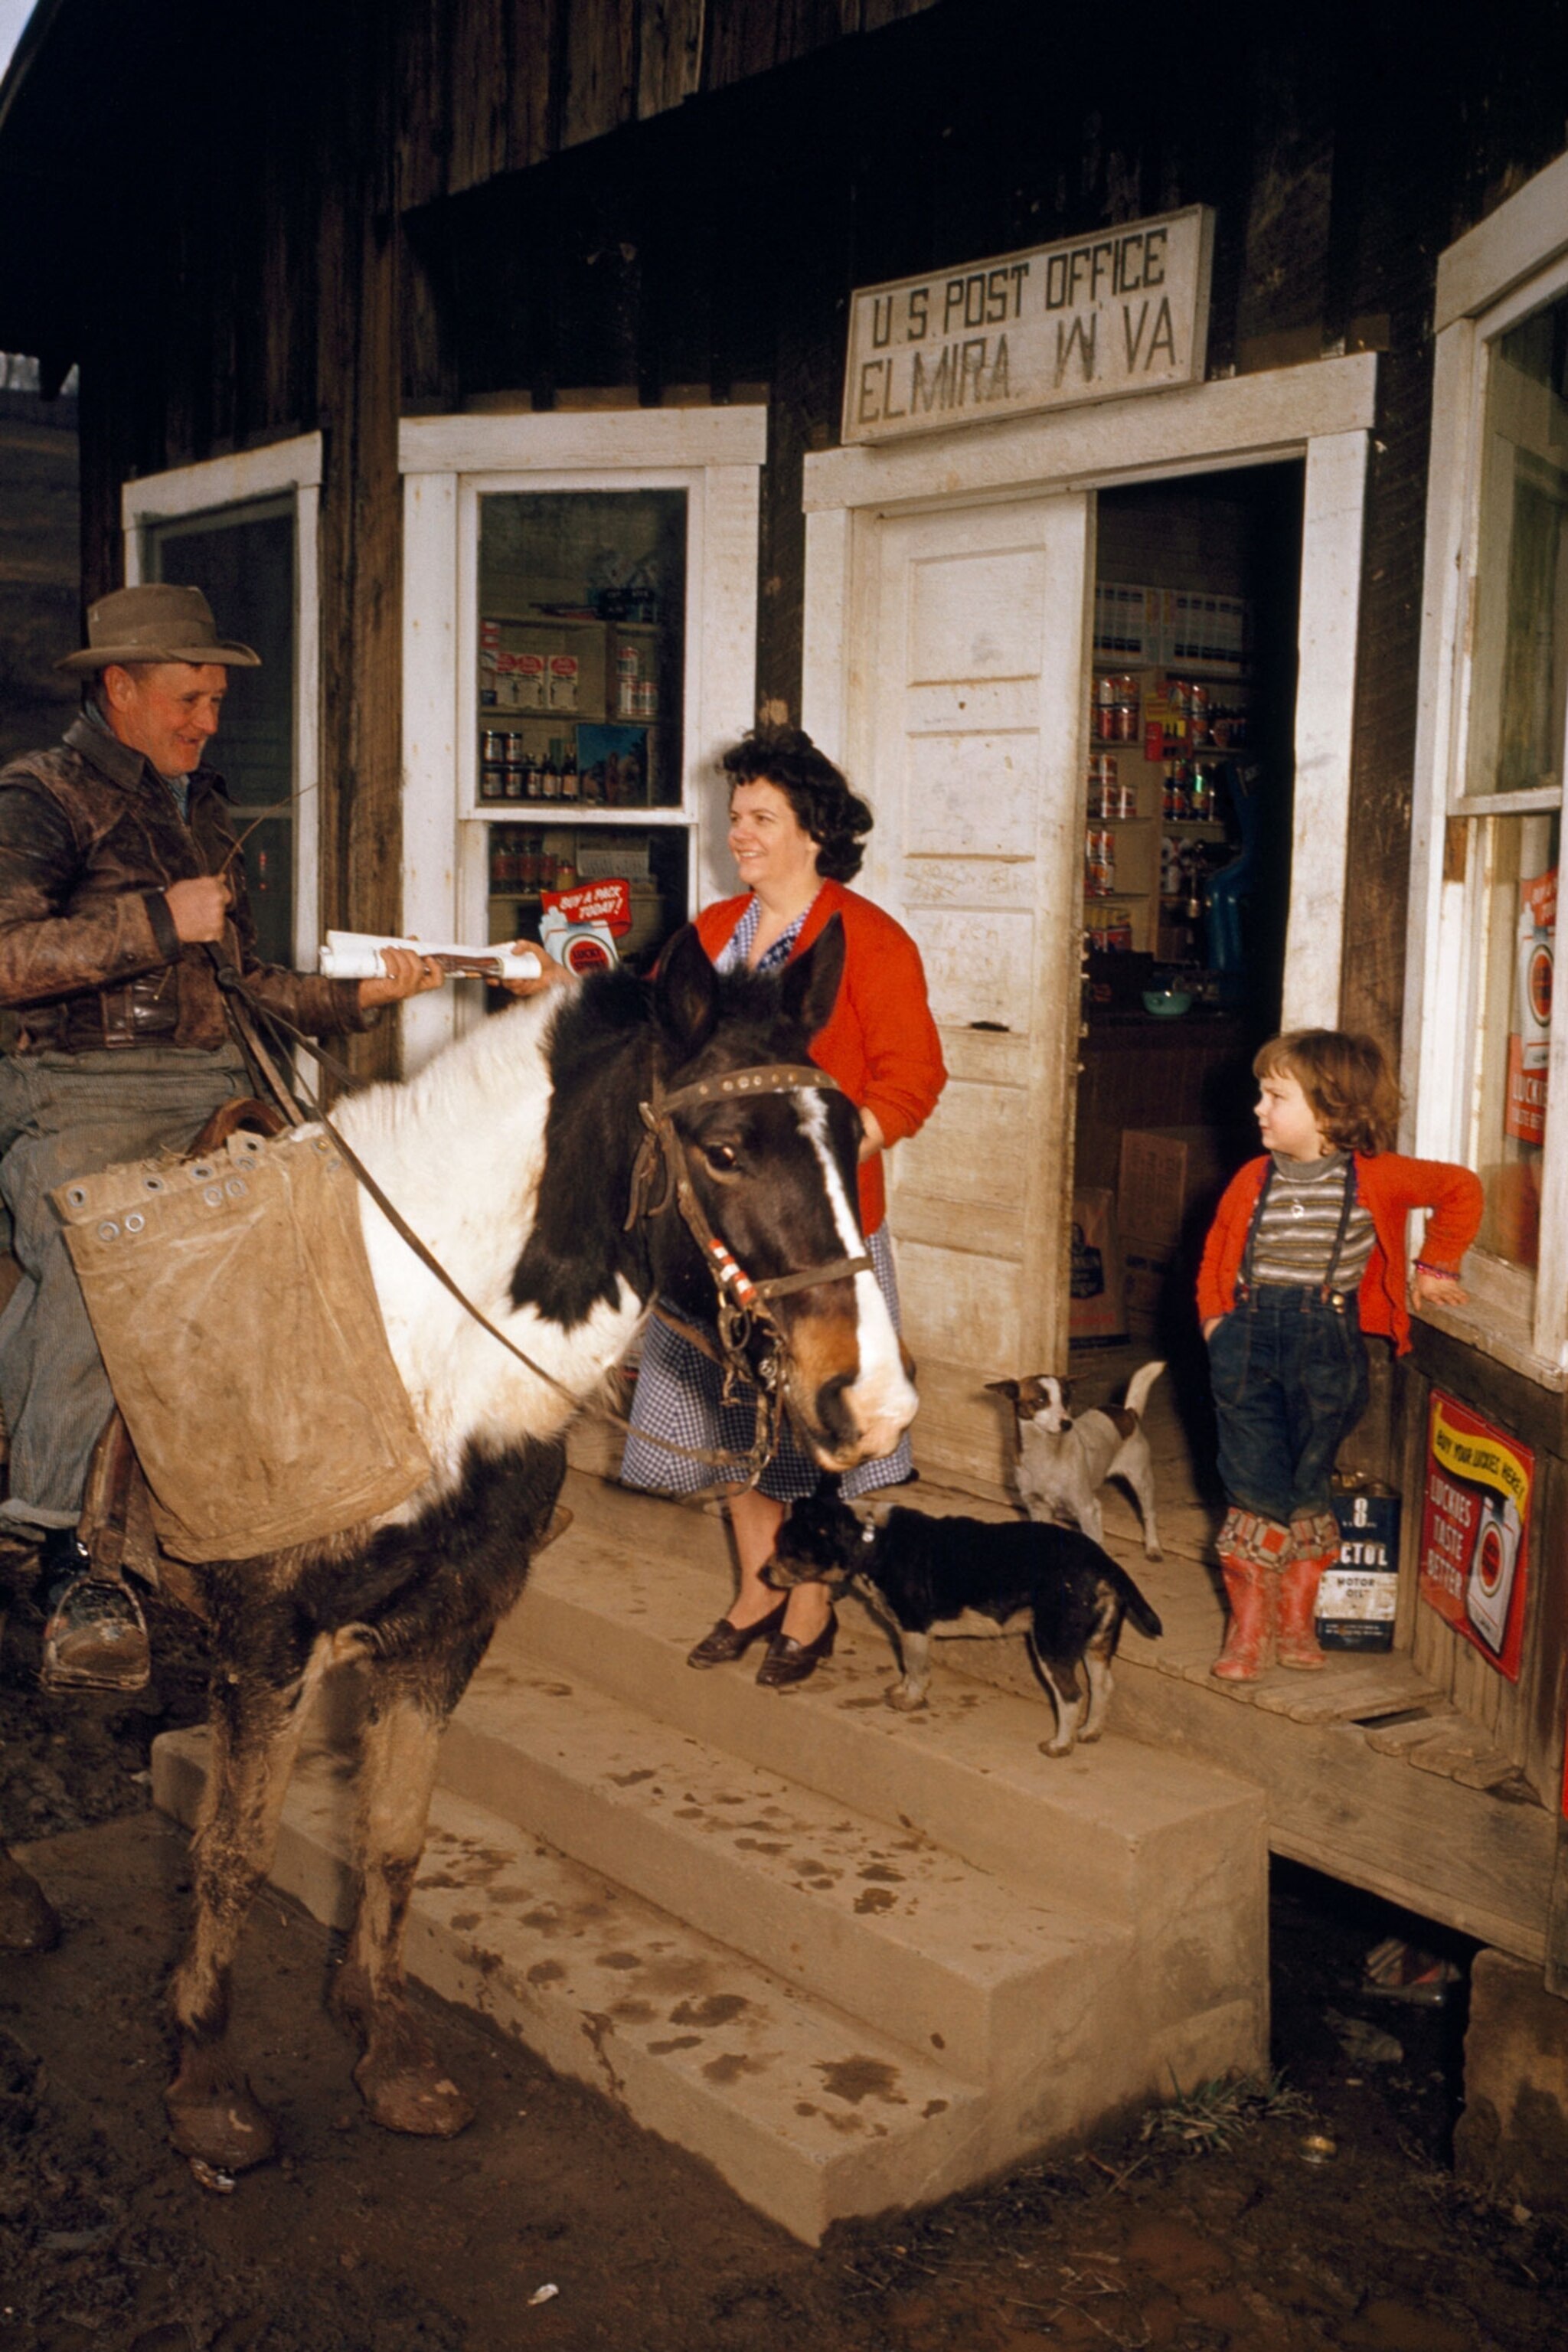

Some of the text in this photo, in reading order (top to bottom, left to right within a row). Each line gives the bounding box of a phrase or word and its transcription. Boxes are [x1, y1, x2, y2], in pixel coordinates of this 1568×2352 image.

[943, 263, 1030, 335] POST
[1045, 227, 1169, 312] OFFICE
[1353, 1497, 1368, 1528] 8
[1429, 1474, 1472, 1527] LUCKIES
[1433, 1514, 1464, 1560] TASTE
[1337, 1577, 1376, 1587] MOTOR
[1346, 1589, 1364, 1598] OIL
[1427, 1548, 1462, 1600] BETTER
